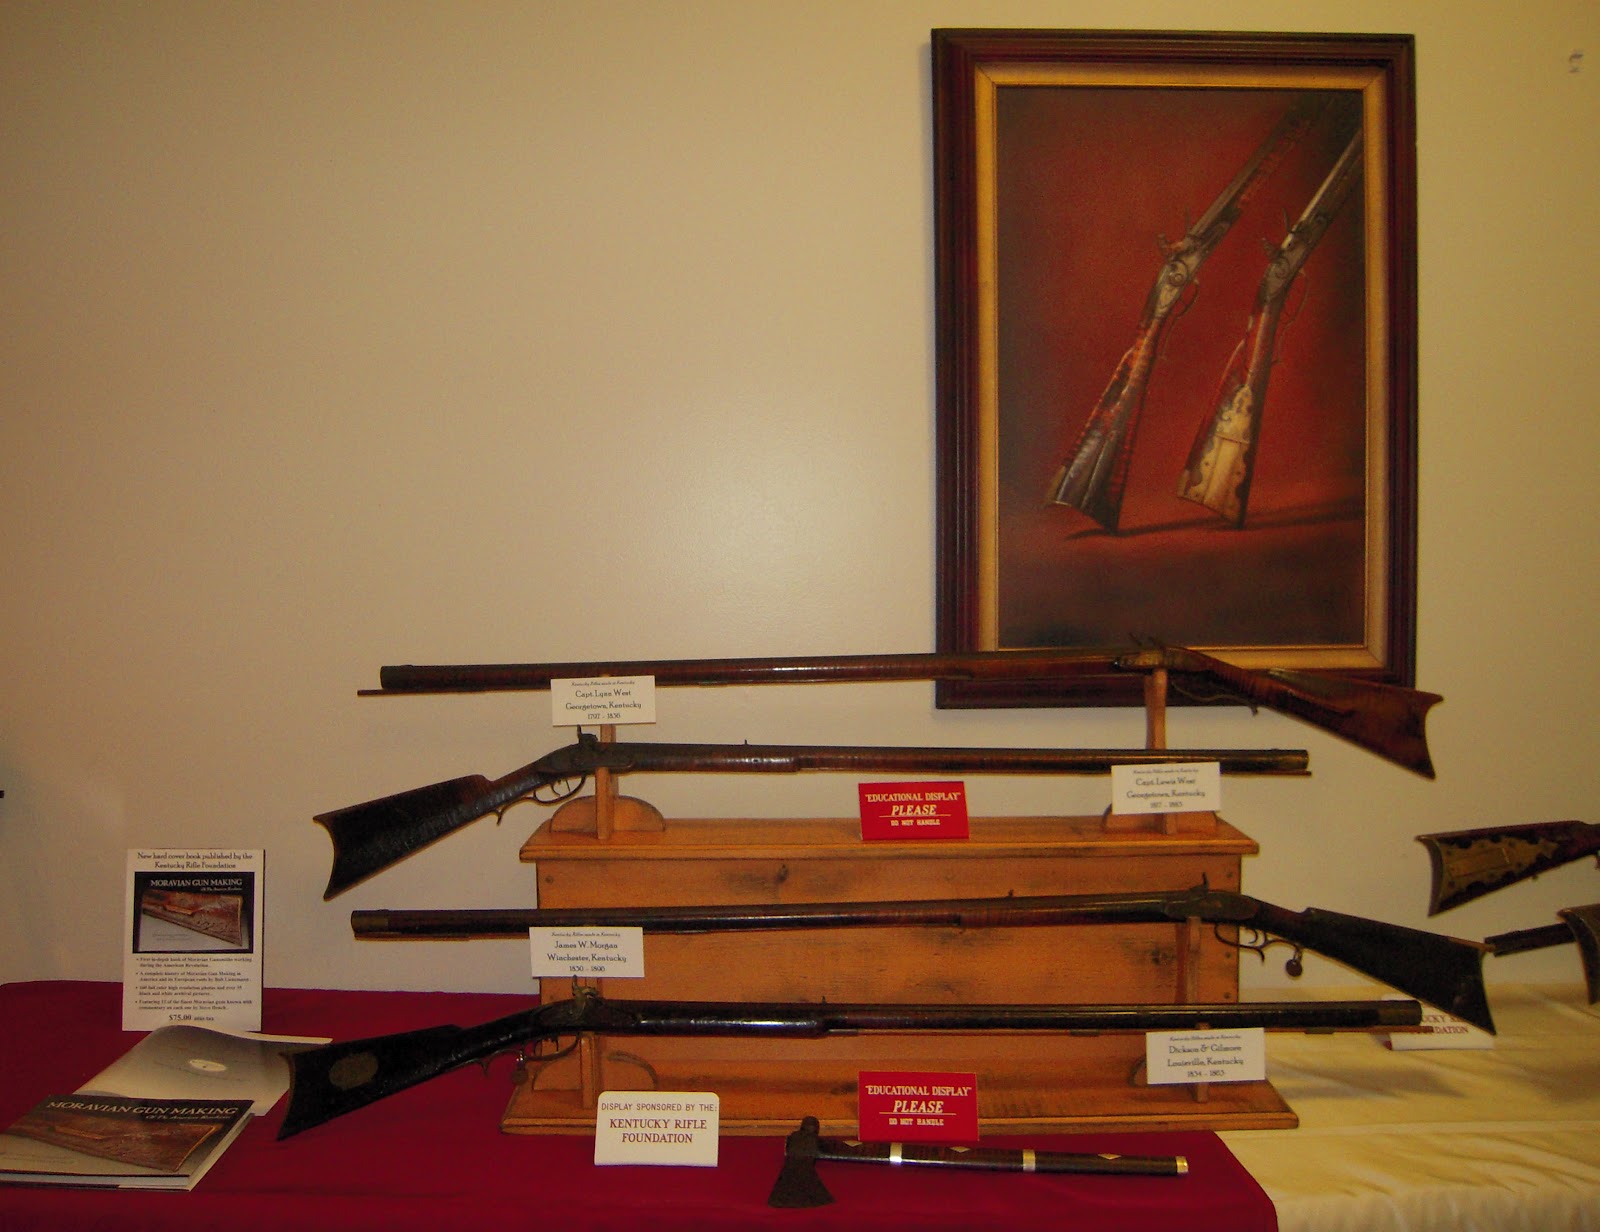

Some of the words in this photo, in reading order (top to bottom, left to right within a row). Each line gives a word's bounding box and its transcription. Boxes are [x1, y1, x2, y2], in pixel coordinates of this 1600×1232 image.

[565, 702, 607, 711] Georgetown,
[609, 701, 641, 709] Kentucky
[1171, 789, 1206, 797] Kentucky
[891, 804, 937, 816] PLEASE
[590, 941, 618, 950] Morgan
[547, 953, 590, 962] Winchester,
[591, 954, 626, 963] Kentucky
[1169, 1046, 1199, 1054] Dickson
[1210, 1044, 1242, 1052] Gilmore
[1167, 1058, 1206, 1067] Louisville,
[1207, 1057, 1244, 1065] Kentucky
[46, 1101, 133, 1114] MORAVIAN
[133, 1106, 171, 1114] GUN
[170, 1107, 238, 1115] MAKING
[893, 1100, 944, 1113] PLEASE
[610, 1119, 670, 1128] KENTUCKY
[674, 1119, 707, 1129] RIFLE
[622, 1133, 693, 1143] FOUNDATION
